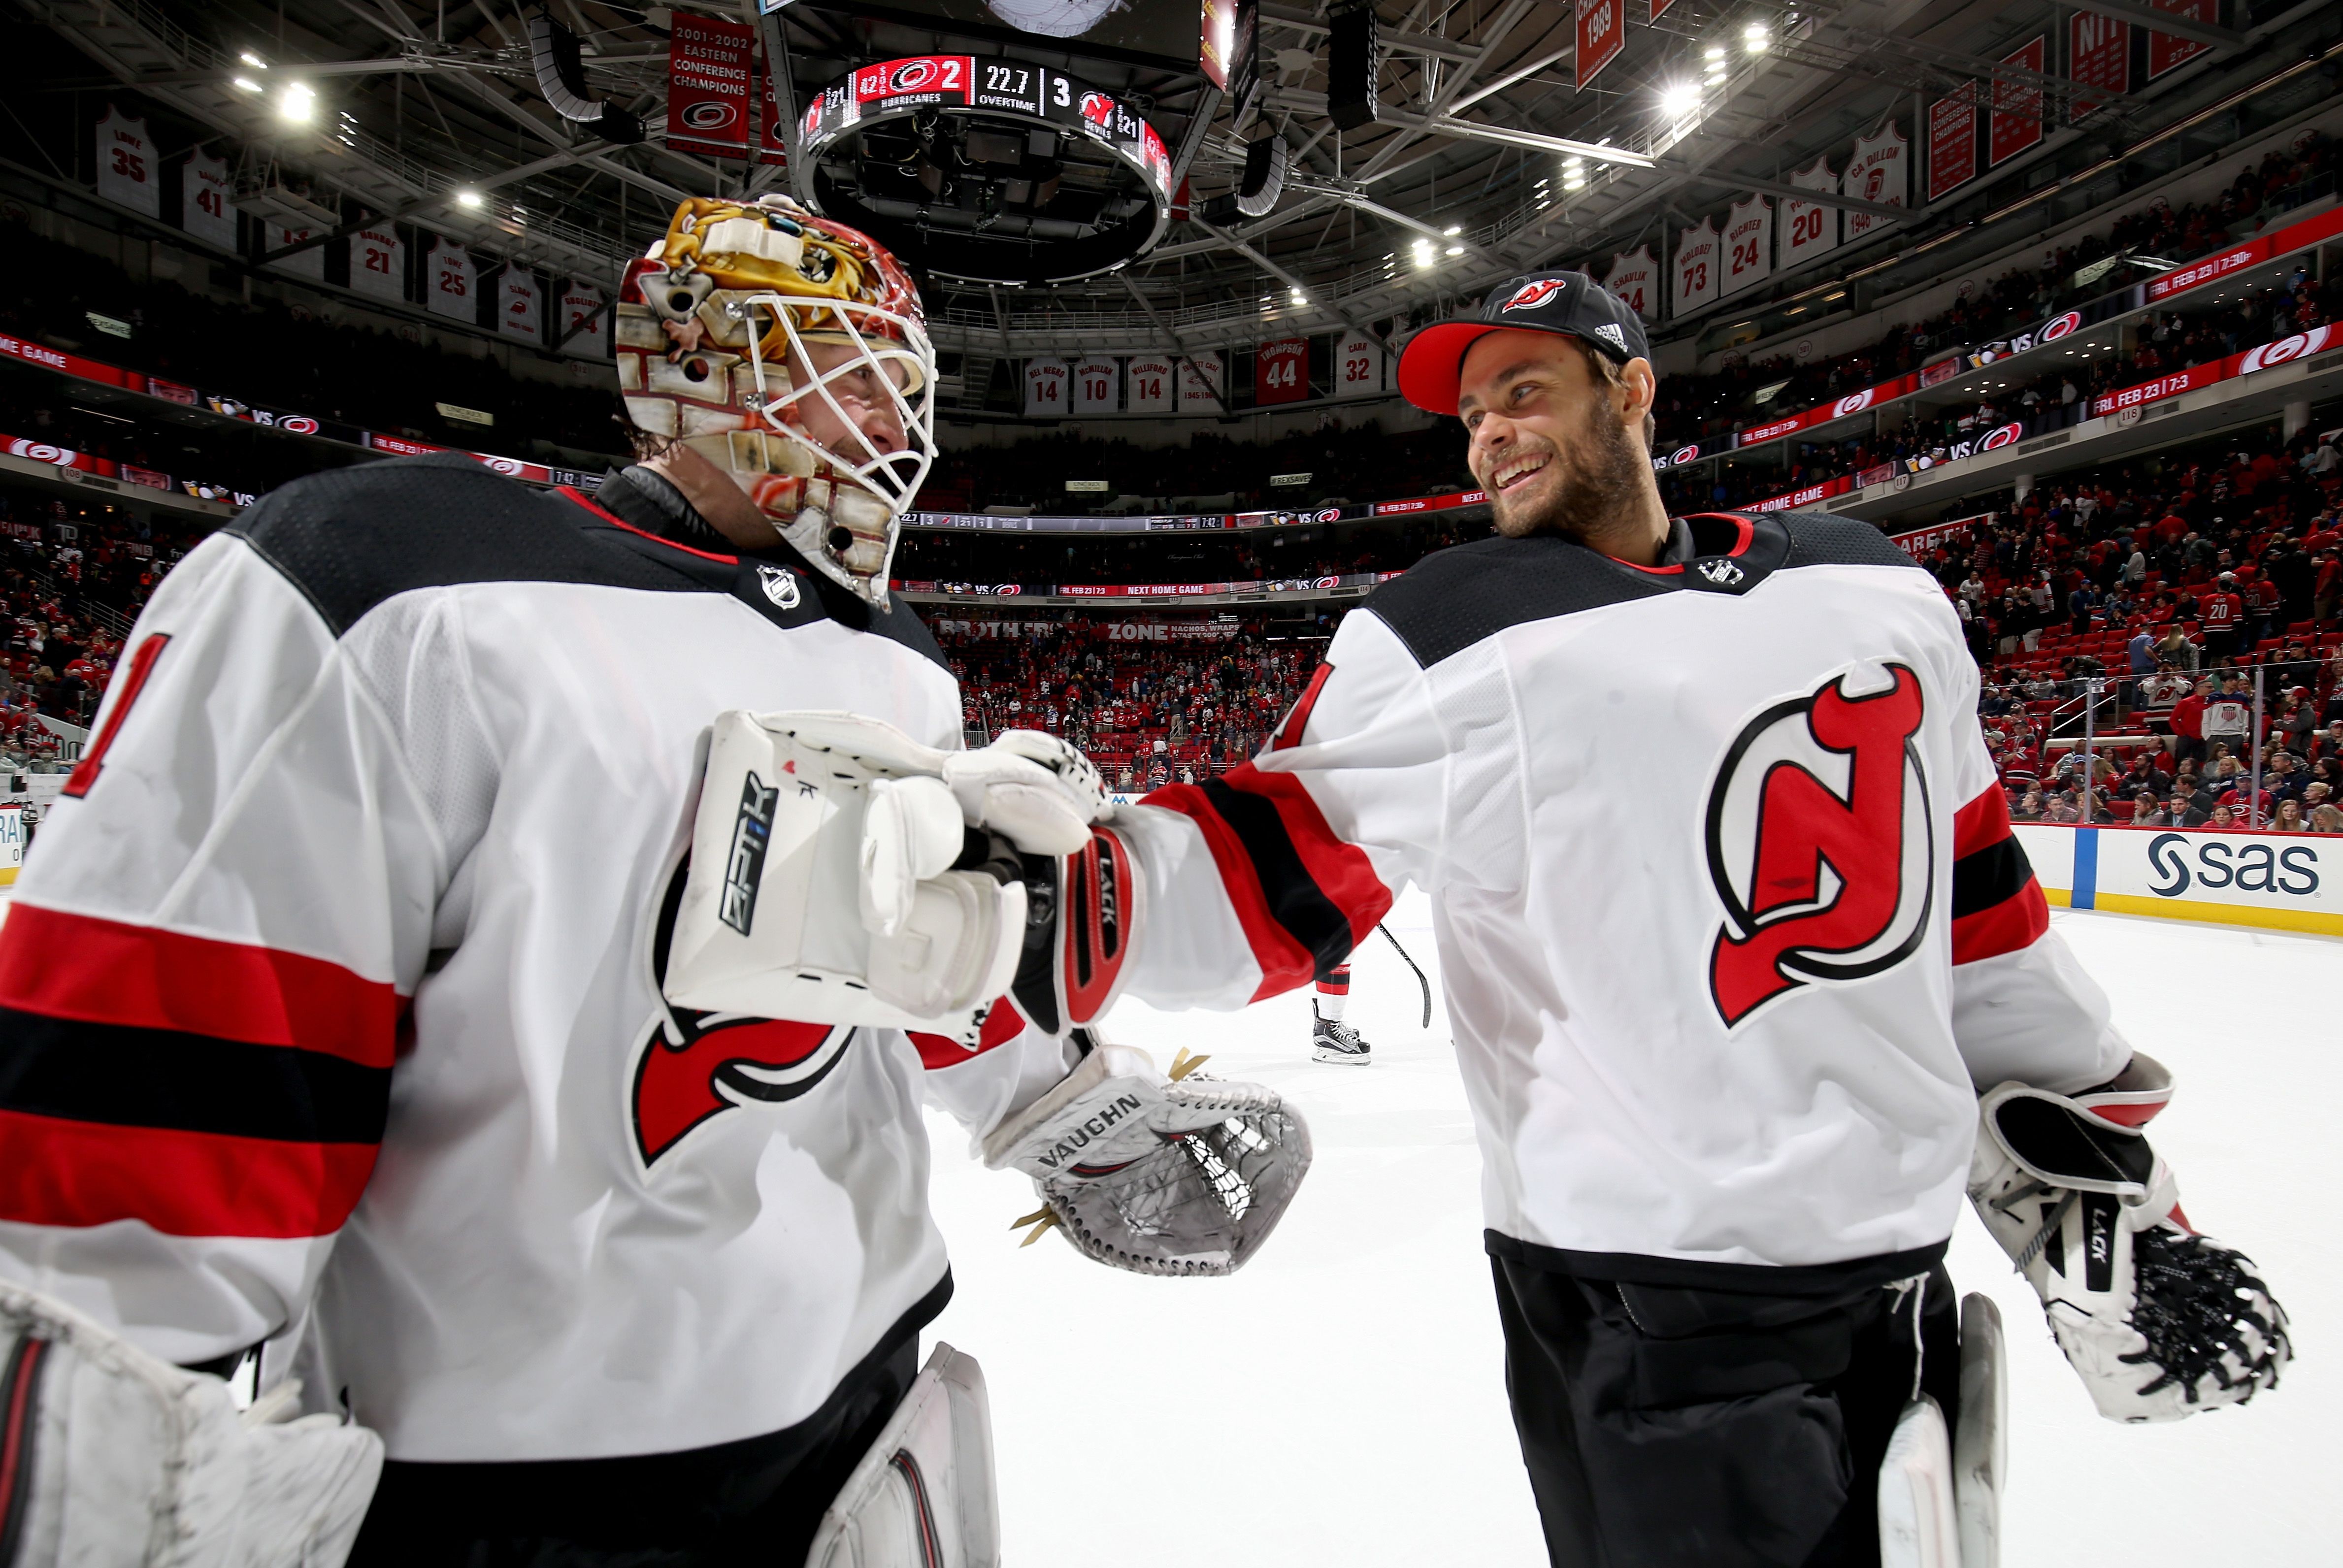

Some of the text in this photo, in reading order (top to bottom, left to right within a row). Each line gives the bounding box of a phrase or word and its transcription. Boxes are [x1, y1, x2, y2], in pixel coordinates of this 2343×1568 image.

[1587, 0, 1612, 48] 1989
[676, 27, 748, 49] 2001-2002
[684, 44, 738, 63] EASTERN
[2169, 42, 2196, 63] 27-0
[674, 59, 746, 81] CONFERENCE
[941, 60, 960, 89] 2
[987, 65, 1028, 95] 22.7
[673, 75, 745, 96] CHAMPIONS
[859, 75, 878, 95] 42
[1054, 77, 1071, 107] 3
[881, 93, 941, 108] HURRICANES
[979, 95, 1036, 112] OVERTIME
[1123, 115, 1137, 138] 21
[1935, 113, 1971, 142] CHAMPIONS
[114, 130, 142, 150] LOWE
[112, 148, 145, 183] 35
[1867, 147, 1900, 166] DILLON
[198, 188, 221, 218] 41
[1730, 219, 1762, 242] RICHTER
[1793, 207, 1822, 248] 20
[366, 248, 389, 274] 21
[444, 256, 463, 269] TOWE
[1733, 237, 1759, 276] 24
[441, 270, 465, 296] 25
[1614, 271, 1647, 289] SHAVLIK
[1684, 262, 1707, 298] 73
[2173, 270, 2195, 288] FEB
[2197, 263, 2212, 282] 23
[1349, 343, 1367, 353] CARR
[1594, 325, 1629, 353] adidas
[2011, 333, 2032, 354] VS
[22, 346, 66, 368] GAME
[1260, 342, 1304, 361] THOMPSON
[1029, 366, 1065, 379] DEL NEGRO
[1132, 363, 1168, 376] WILLIFORD
[1205, 361, 1219, 372] CASE
[1266, 359, 1297, 389] 44
[1346, 358, 1370, 382] 32
[1036, 381, 1057, 402] 14
[1086, 380, 1107, 400] 10
[1139, 379, 1161, 399] 14
[2118, 390, 2142, 407] FEB
[2145, 384, 2160, 400] 23
[2169, 375, 2188, 391] 7:3
[252, 409, 274, 425] VS
[2122, 409, 2137, 422] 118
[1769, 425, 1779, 436] 23
[406, 445, 416, 455] 23
[1950, 442, 1971, 461] VS
[66, 468, 80, 480] 108
[1271, 475, 1312, 485] #REXSAVES
[1896, 476, 1907, 486] 117
[233, 492, 255, 507] VS
[1462, 492, 1484, 503] NEXT
[1761, 487, 1823, 511] HOME GAME
[926, 515, 933, 525] 3
[1298, 514, 1312, 524] VS
[975, 585, 989, 595] VS
[1127, 585, 1204, 595] NEXT HOME GAME
[1296, 579, 1310, 590] VS
[2210, 604, 2228, 620] 20
[1108, 623, 1168, 640] ZONE
[1099, 857, 1116, 926] LACK
[1038, 1093, 1141, 1170] VAUGHN
[2092, 1208, 2108, 1264] LACK
